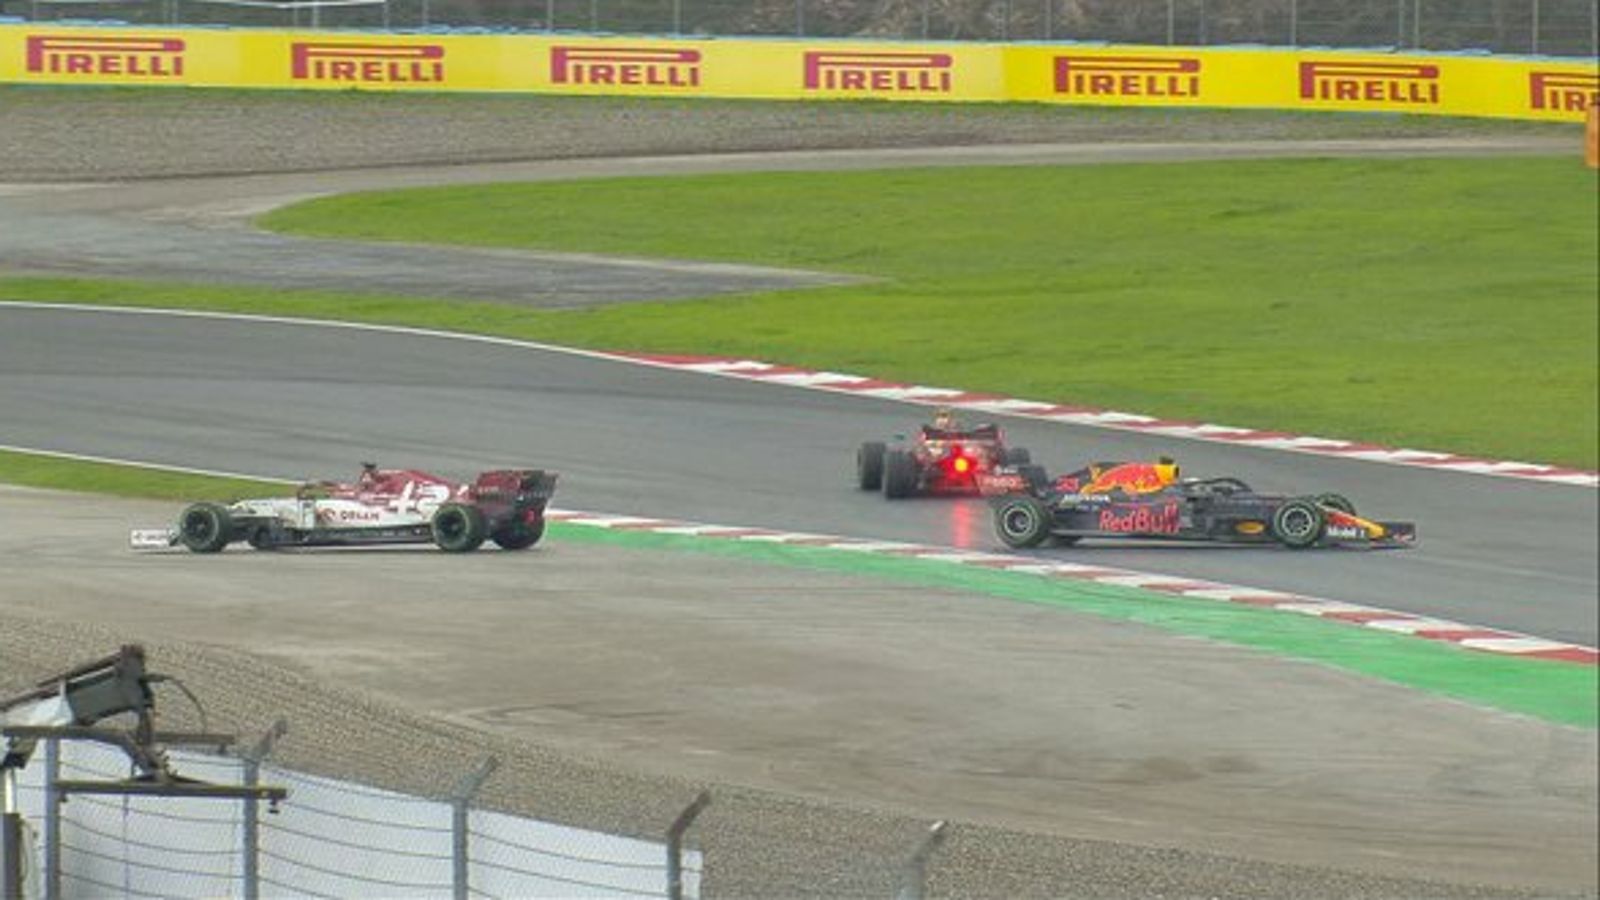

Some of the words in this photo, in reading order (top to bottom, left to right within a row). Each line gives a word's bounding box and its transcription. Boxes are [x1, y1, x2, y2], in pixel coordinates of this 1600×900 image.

[26, 35, 185, 77] PIRELLI
[291, 43, 445, 82] PIRELLI
[550, 46, 701, 87] PIRELLI
[803, 51, 953, 92] PIRELLI
[1053, 56, 1201, 98] PIRELLI
[1299, 61, 1440, 104] PIRELLI
